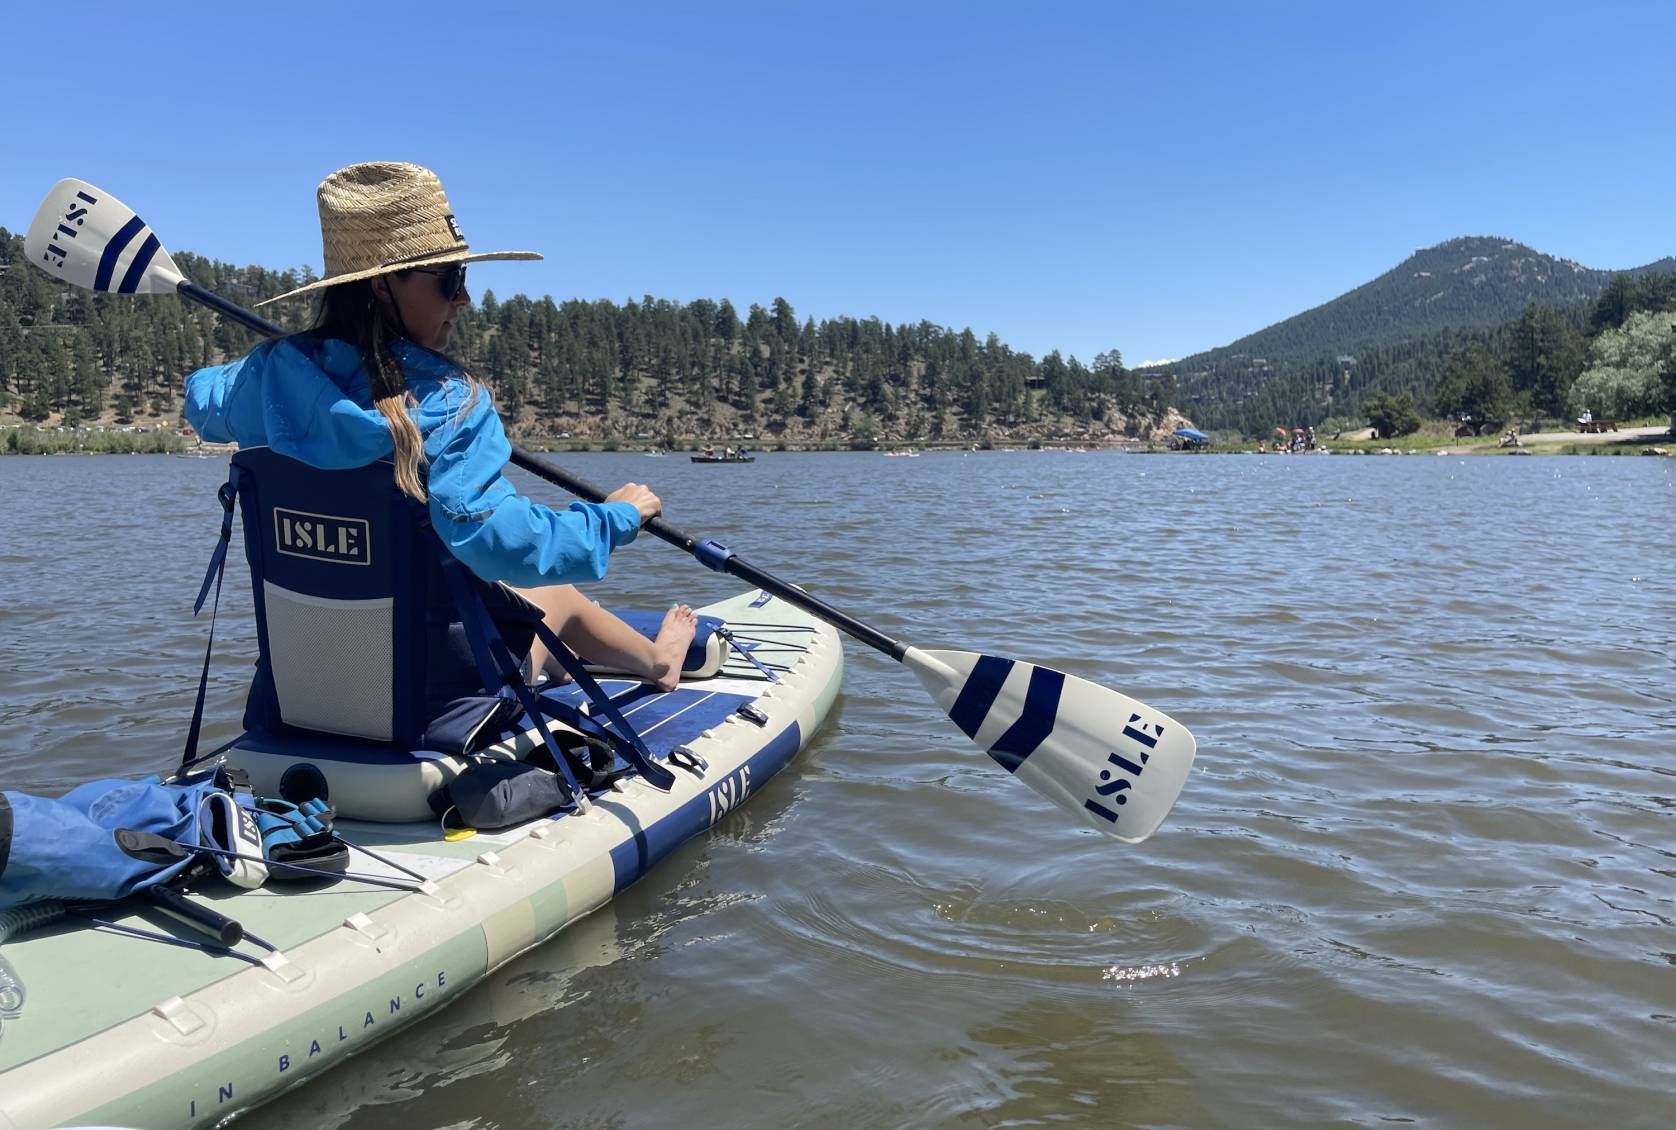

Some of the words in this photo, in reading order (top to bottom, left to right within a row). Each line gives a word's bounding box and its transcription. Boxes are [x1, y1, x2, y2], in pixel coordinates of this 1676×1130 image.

[43, 190, 98, 269] ISLE
[283, 518, 359, 555] ISLE
[708, 764, 751, 826] ISLE
[1084, 712, 1165, 824] ISLE
[189, 1082, 233, 1118] IN
[279, 971, 446, 1073] BALANCE
